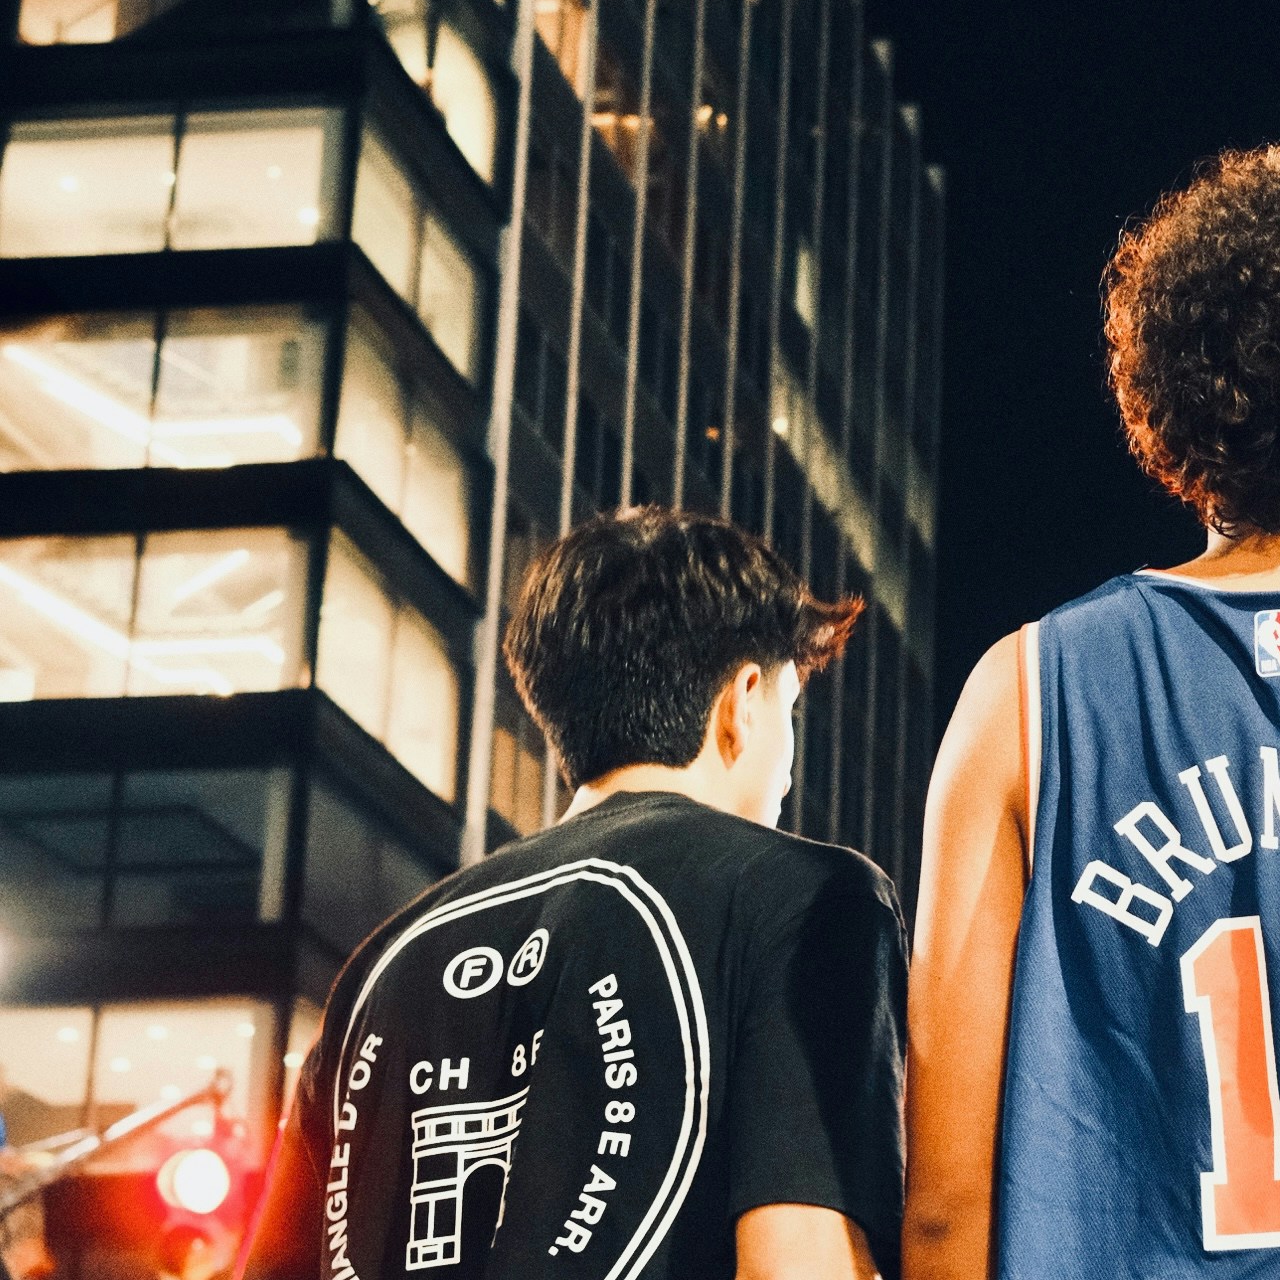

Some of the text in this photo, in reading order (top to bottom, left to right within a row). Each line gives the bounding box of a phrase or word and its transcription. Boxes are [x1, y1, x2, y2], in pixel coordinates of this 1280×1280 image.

[409, 1057, 471, 1095] CH
[588, 973, 638, 1090] PARIS
[548, 1163, 617, 1258] ARR.
